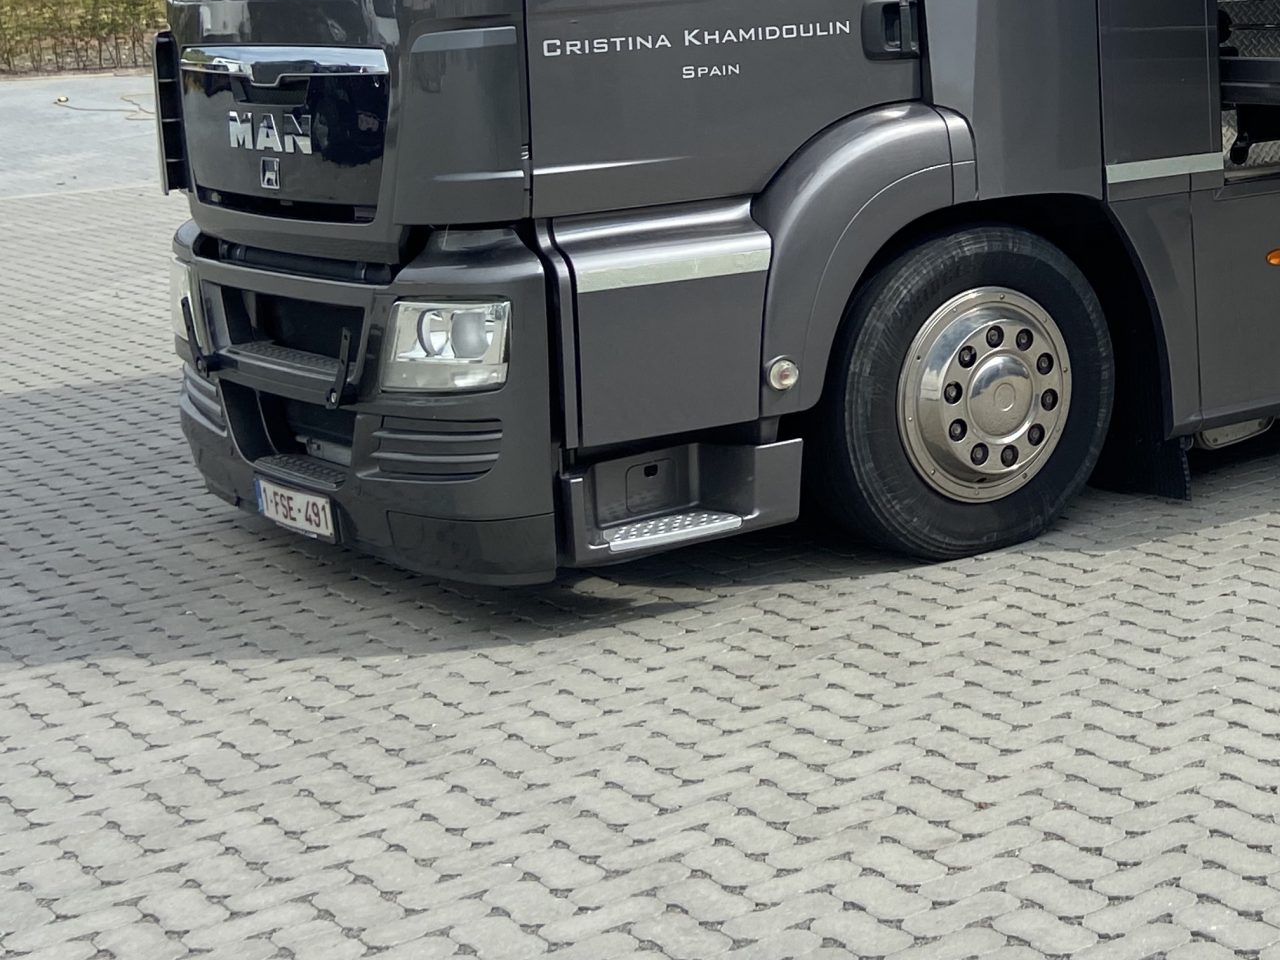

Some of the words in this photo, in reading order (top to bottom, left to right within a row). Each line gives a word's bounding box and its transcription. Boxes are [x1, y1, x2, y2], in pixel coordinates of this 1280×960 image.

[542, 33, 672, 57] CRISTINA
[683, 20, 851, 47] KHAMIDOULIN
[682, 63, 740, 79] SPAIN
[228, 110, 312, 155] MAN
